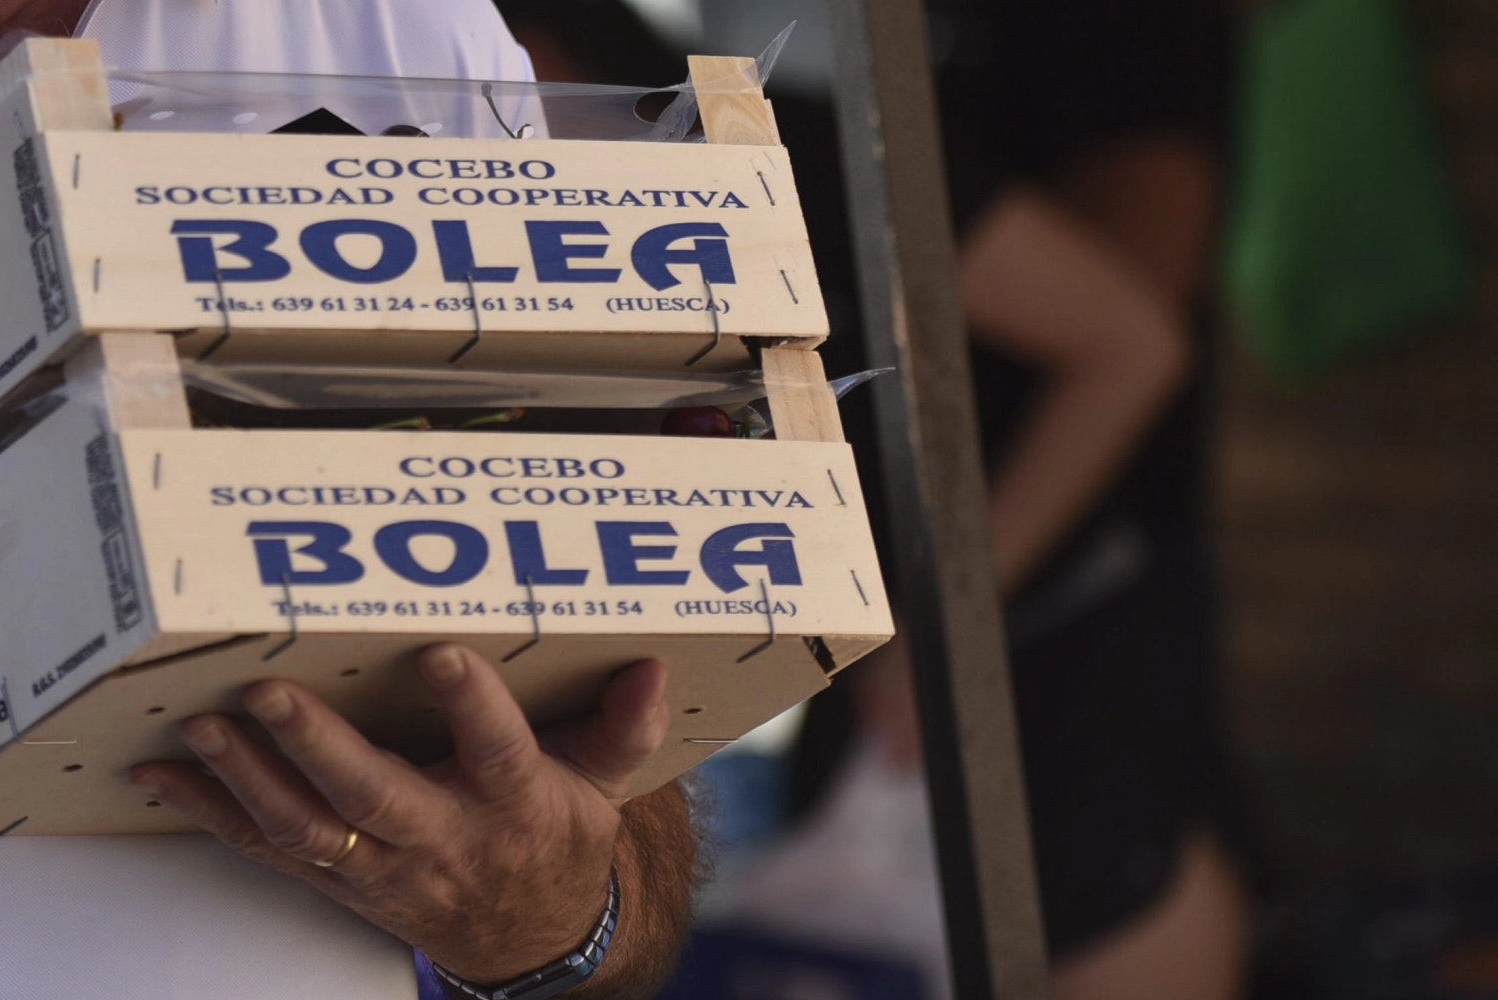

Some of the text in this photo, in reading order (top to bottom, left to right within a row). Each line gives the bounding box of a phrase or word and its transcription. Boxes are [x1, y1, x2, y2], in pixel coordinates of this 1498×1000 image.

[325, 158, 556, 179] COCEBO
[134, 186, 750, 209] SOCIEDAD COOPERATIVA
[169, 218, 737, 293] BOLEA
[271, 297, 314, 312] 639
[320, 297, 346, 312] 61
[354, 297, 382, 312] 31
[387, 297, 415, 312] 24
[434, 297, 475, 312] 639
[481, 297, 508, 312] 61
[514, 297, 541, 312] 31
[547, 297, 575, 312] 54
[605, 297, 731, 314] (HUESCA)
[398, 457, 625, 479] COCEBO
[210, 486, 815, 509] SOCIEDAD COOPERATIVA
[245, 519, 804, 594] BOLEA
[346, 601, 388, 616] 639
[394, 601, 419, 616] 61
[426, 601, 452, 616] 31
[459, 601, 486, 616] 24
[505, 601, 546, 616] 639
[552, 601, 577, 616] 61
[584, 601, 609, 616] 31
[617, 601, 644, 616] 54
[674, 601, 797, 617] (HUESCA)
